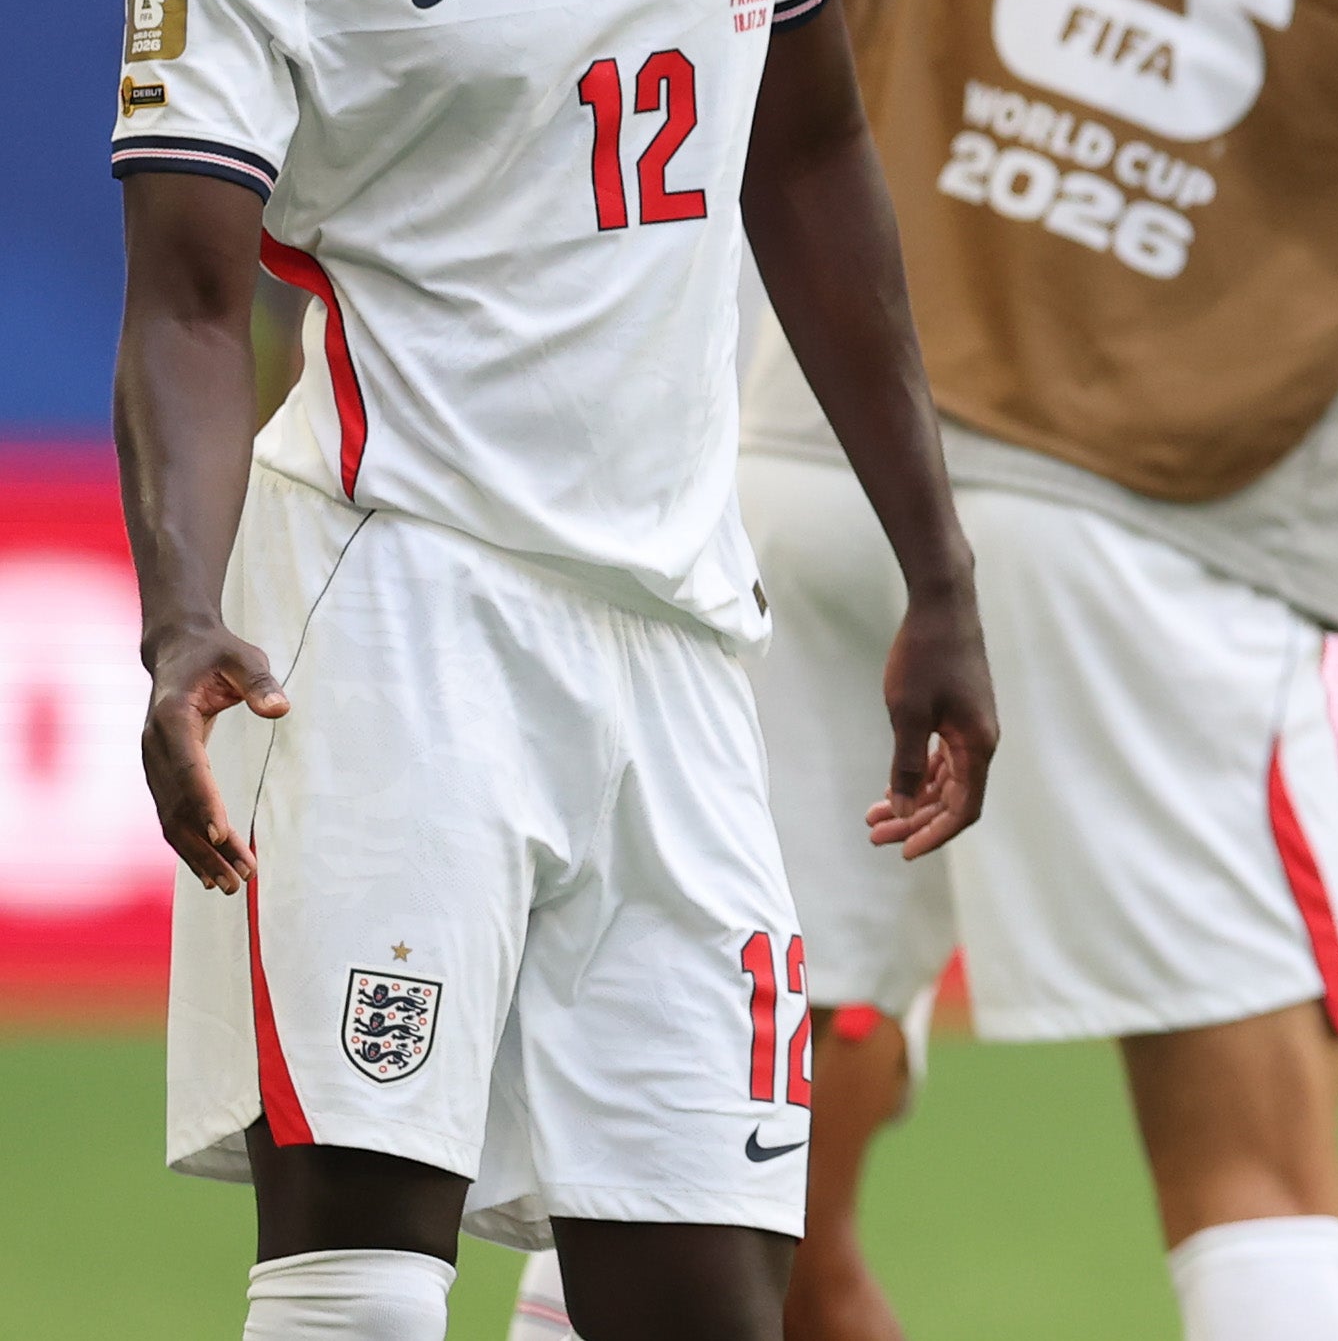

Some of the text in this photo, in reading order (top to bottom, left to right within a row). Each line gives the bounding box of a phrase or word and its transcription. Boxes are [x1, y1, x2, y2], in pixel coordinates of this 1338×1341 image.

[133, 88, 162, 98] DEBUT
[1059, 4, 1175, 86] FIFA
[578, 48, 708, 232] 12
[936, 129, 1195, 280] 2026
[962, 78, 1217, 208] WORLD CUP
